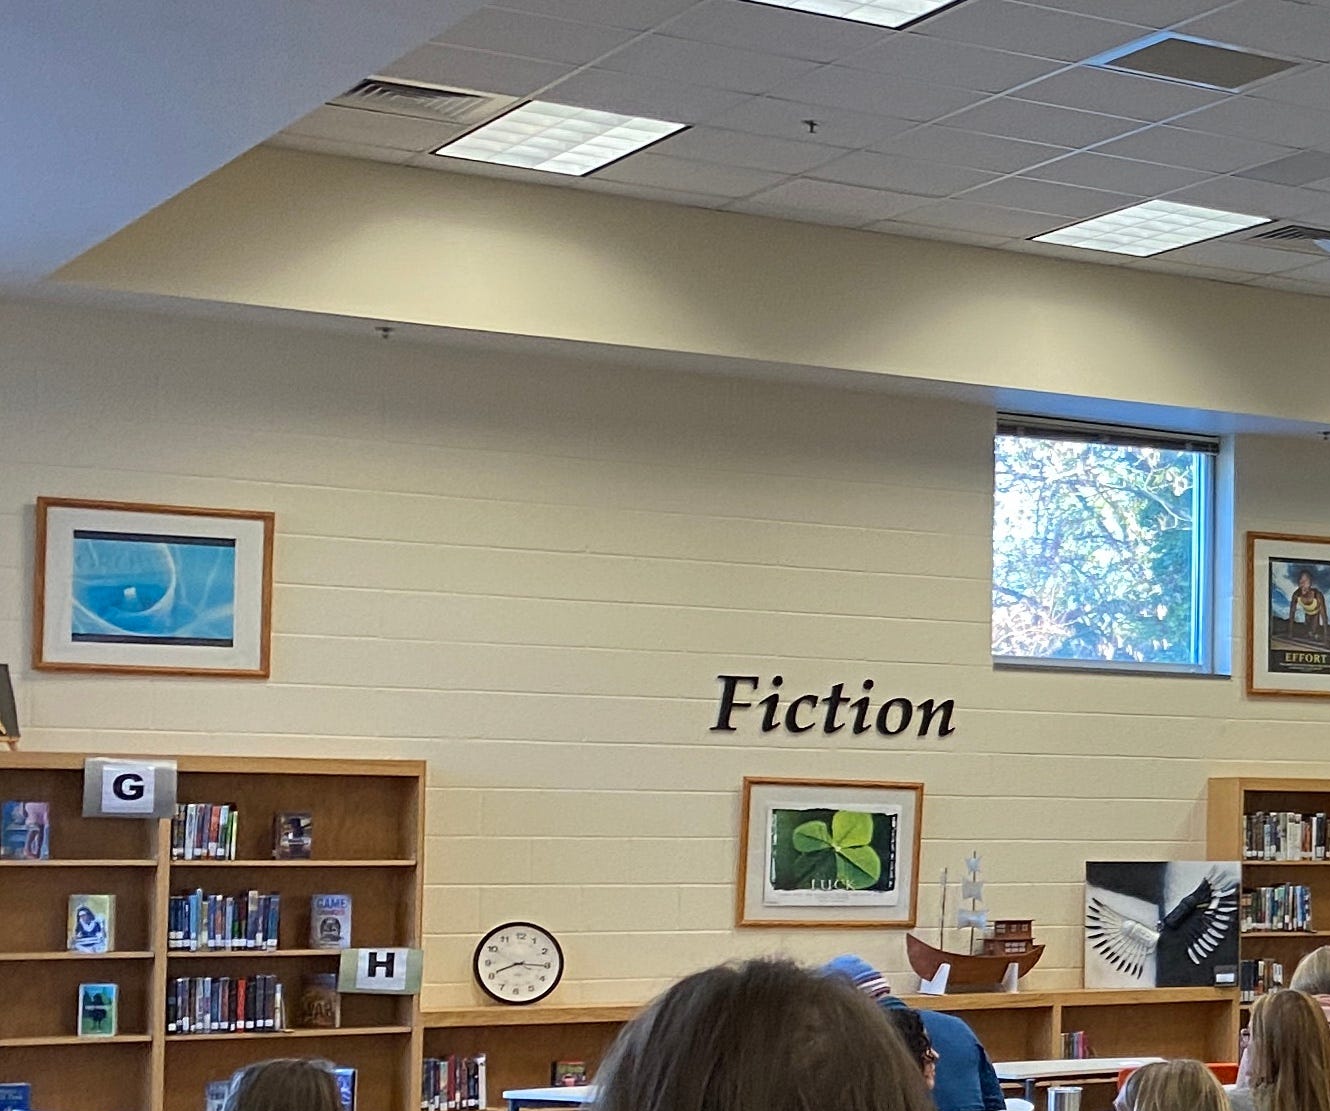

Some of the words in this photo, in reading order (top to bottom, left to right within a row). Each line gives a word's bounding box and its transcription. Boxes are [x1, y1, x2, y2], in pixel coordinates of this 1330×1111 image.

[1285, 652, 1328, 664] EFFORT
[709, 675, 957, 738] Fiction
[112, 773, 145, 801] G
[811, 879, 856, 891] LUCK
[367, 951, 396, 978] H
